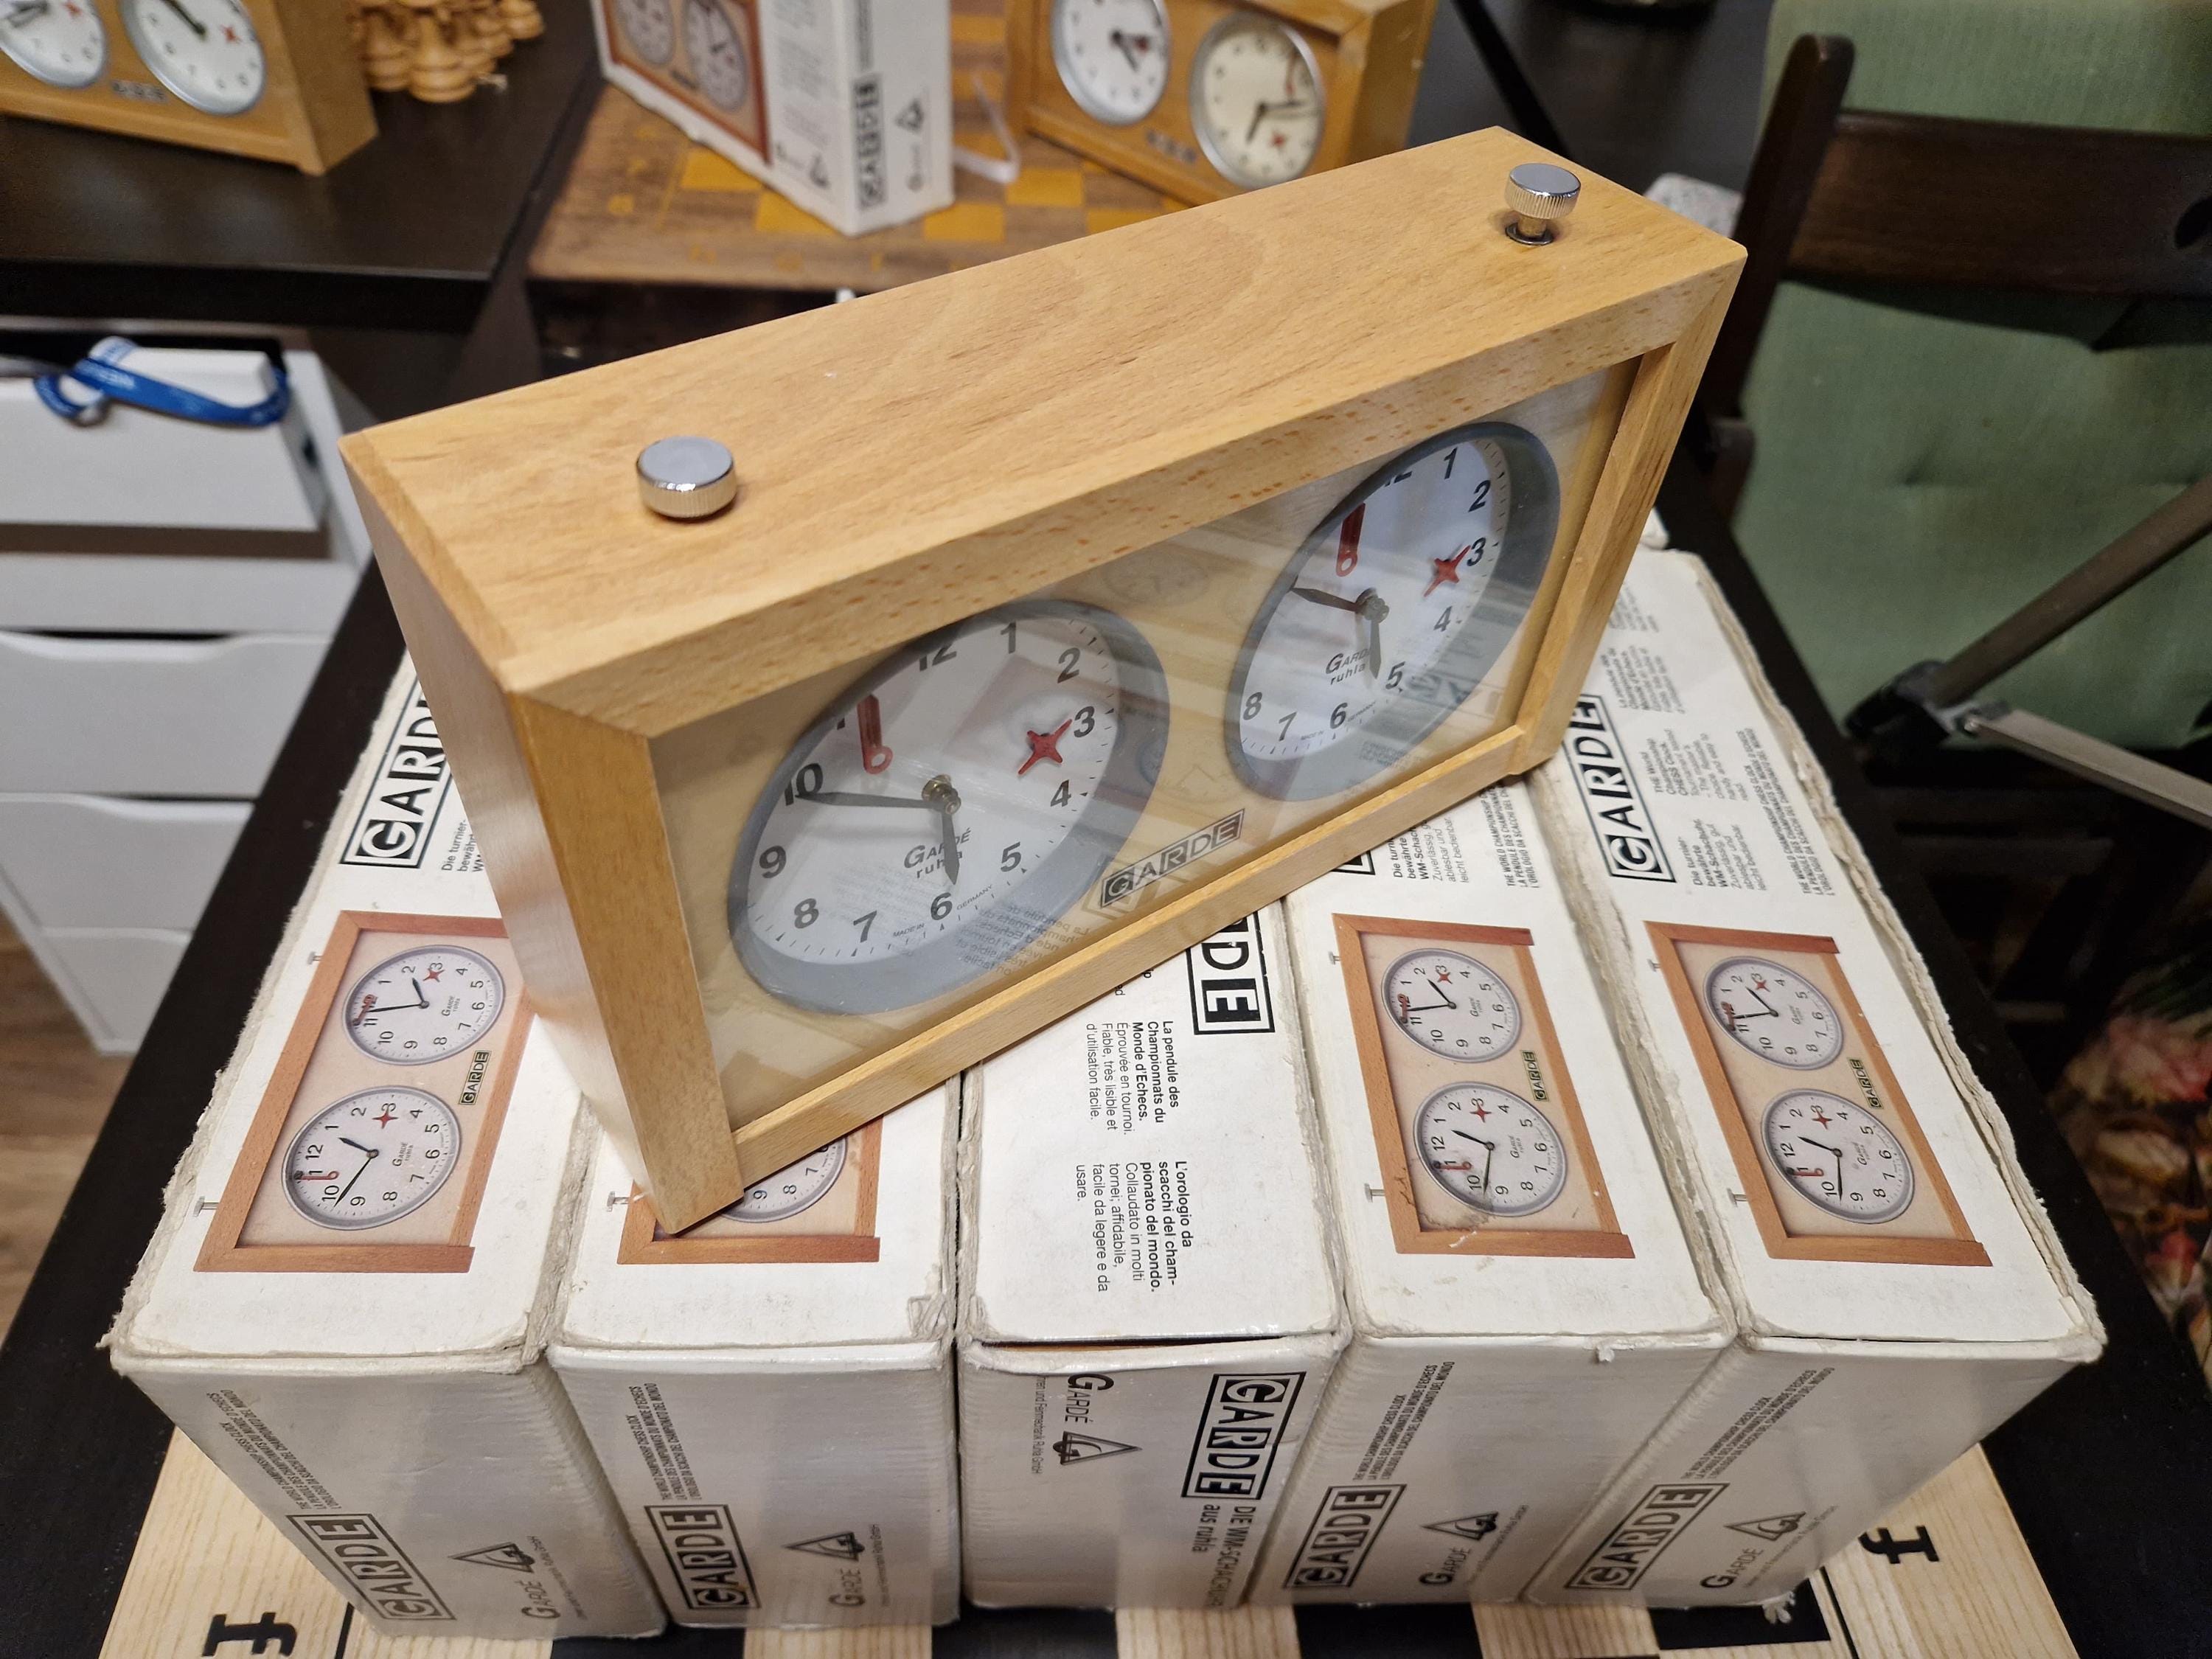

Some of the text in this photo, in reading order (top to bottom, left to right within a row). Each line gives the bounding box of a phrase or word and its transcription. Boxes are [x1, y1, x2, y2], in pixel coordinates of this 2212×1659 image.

[1444, 448, 1457, 479] 1
[1469, 480, 1490, 512] 2
[1467, 538, 1486, 566] 3
[1434, 606, 1452, 632] 4
[1001, 623, 1017, 653] 1
[1057, 648, 1080, 683] 2
[1326, 649, 1370, 675] GARD
[1330, 664, 1366, 685] ruhla
[1385, 661, 1405, 689] 5
[1243, 692, 1262, 720] 8
[1330, 703, 1348, 729] 6
[1074, 706, 1095, 737] 3
[1279, 711, 1297, 741] 7
[355, 699, 446, 859] GARD
[784, 763, 824, 805] 10
[1050, 780, 1071, 807] 4
[442, 857, 456, 872] Die
[759, 846, 787, 877] 9
[917, 852, 963, 878] ruha
[1001, 842, 1021, 872] 5
[1104, 813, 1242, 904] GARDE
[1393, 863, 1403, 877] Die
[931, 892, 953, 920] 6
[957, 885, 992, 910] GERMANY
[794, 898, 819, 928] 8
[853, 911, 877, 942] 7
[892, 926, 915, 936] MADE
[378, 1032, 394, 1043] 10
[404, 1040, 417, 1048] 9
[1086, 1023, 1102, 1119] d'utilisation facile.
[1102, 1023, 1118, 1130] Fiable, très lisible et
[1133, 1022, 1148, 1121] Monde d'Echecs.
[1147, 1021, 1166, 1123] Championnats du
[1162, 1021, 1180, 1107] La pendule des
[1523, 1051, 1548, 1100] GARDE
[460, 1051, 489, 1104] GARDE
[1115, 1023, 1135, 1135] Éprouvée en tournoi.
[1849, 1060, 1882, 1107] GARDE
[351, 1107, 366, 1116] 2
[410, 1109, 422, 1118] 4
[1448, 1102, 1461, 1110] 2
[1498, 1105, 1509, 1113] 4
[1790, 1109, 1803, 1117] 2
[1837, 1112, 1848, 1121] 4
[425, 1124, 439, 1133] 5
[1520, 1119, 1532, 1127] 5
[1860, 1126, 1874, 1135] 5
[305, 1144, 323, 1160] 12
[425, 1150, 439, 1158] 6
[1432, 1136, 1445, 1150] 12
[1534, 1143, 1547, 1152] 6
[1781, 1143, 1795, 1157] 12
[1879, 1150, 1892, 1159] 6
[410, 1174, 425, 1183] 7
[805, 1166, 818, 1177] 7
[1534, 1165, 1547, 1173] 7
[1882, 1172, 1895, 1180] 7
[322, 1186, 339, 1201] 10
[753, 1189, 768, 1200] 9
[783, 1184, 797, 1194] 8
[1076, 1164, 1088, 1201] usare.
[1467, 1175, 1481, 1191] 10
[1495, 1186, 1509, 1194] 9
[1521, 1181, 1534, 1191] 8
[1822, 1181, 1837, 1197] 10
[1874, 1189, 1886, 1197] 8
[350, 1197, 366, 1206] 9
[383, 1192, 397, 1200] 8
[1175, 1161, 1194, 1247] L'orologio da
[1851, 1192, 1863, 1201] 9
[1093, 1164, 1110, 1292] facile da legere e da
[1109, 1163, 1126, 1267] tornei; affidabile,
[1125, 1163, 1145, 1281] Collaudato in molti
[1139, 1162, 1163, 1292] pionato del mondo.
[1158, 1161, 1177, 1285] scacchi del cham-
[1194, 1377, 1292, 1496] GARDE
[1231, 1506, 1257, 1523] DIE
[1192, 1504, 1221, 1552] aus ruhla
[1294, 1487, 1392, 1587] GARDE
[1578, 1486, 1711, 1585] GARDE
[305, 1517, 441, 1618] GARDE
[660, 1509, 749, 1607] GARDE
